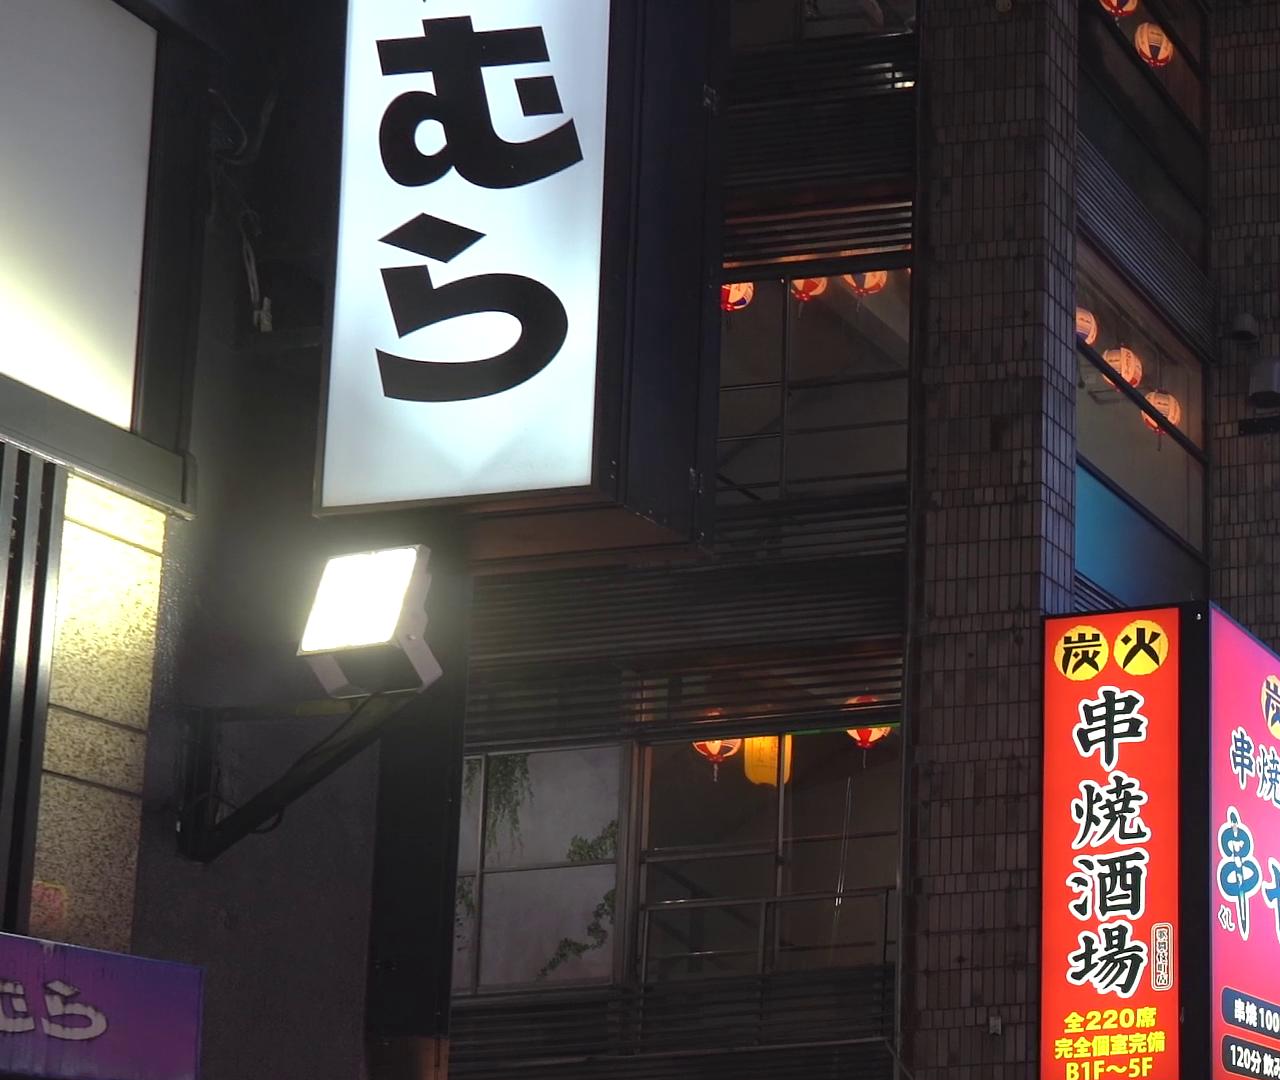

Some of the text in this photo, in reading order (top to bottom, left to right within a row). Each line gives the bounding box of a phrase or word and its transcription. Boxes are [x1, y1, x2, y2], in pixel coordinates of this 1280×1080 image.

[375, 15, 584, 402] むら
[1062, 625, 1160, 675] 炭火
[1071, 688, 1150, 995] 串焼酒場
[1063, 1006, 1157, 1035] 全220席
[1234, 998, 1258, 1028] 串焼
[1054, 1032, 1165, 1061] 完全個室完備
[1230, 1044, 1262, 1075] 120分
